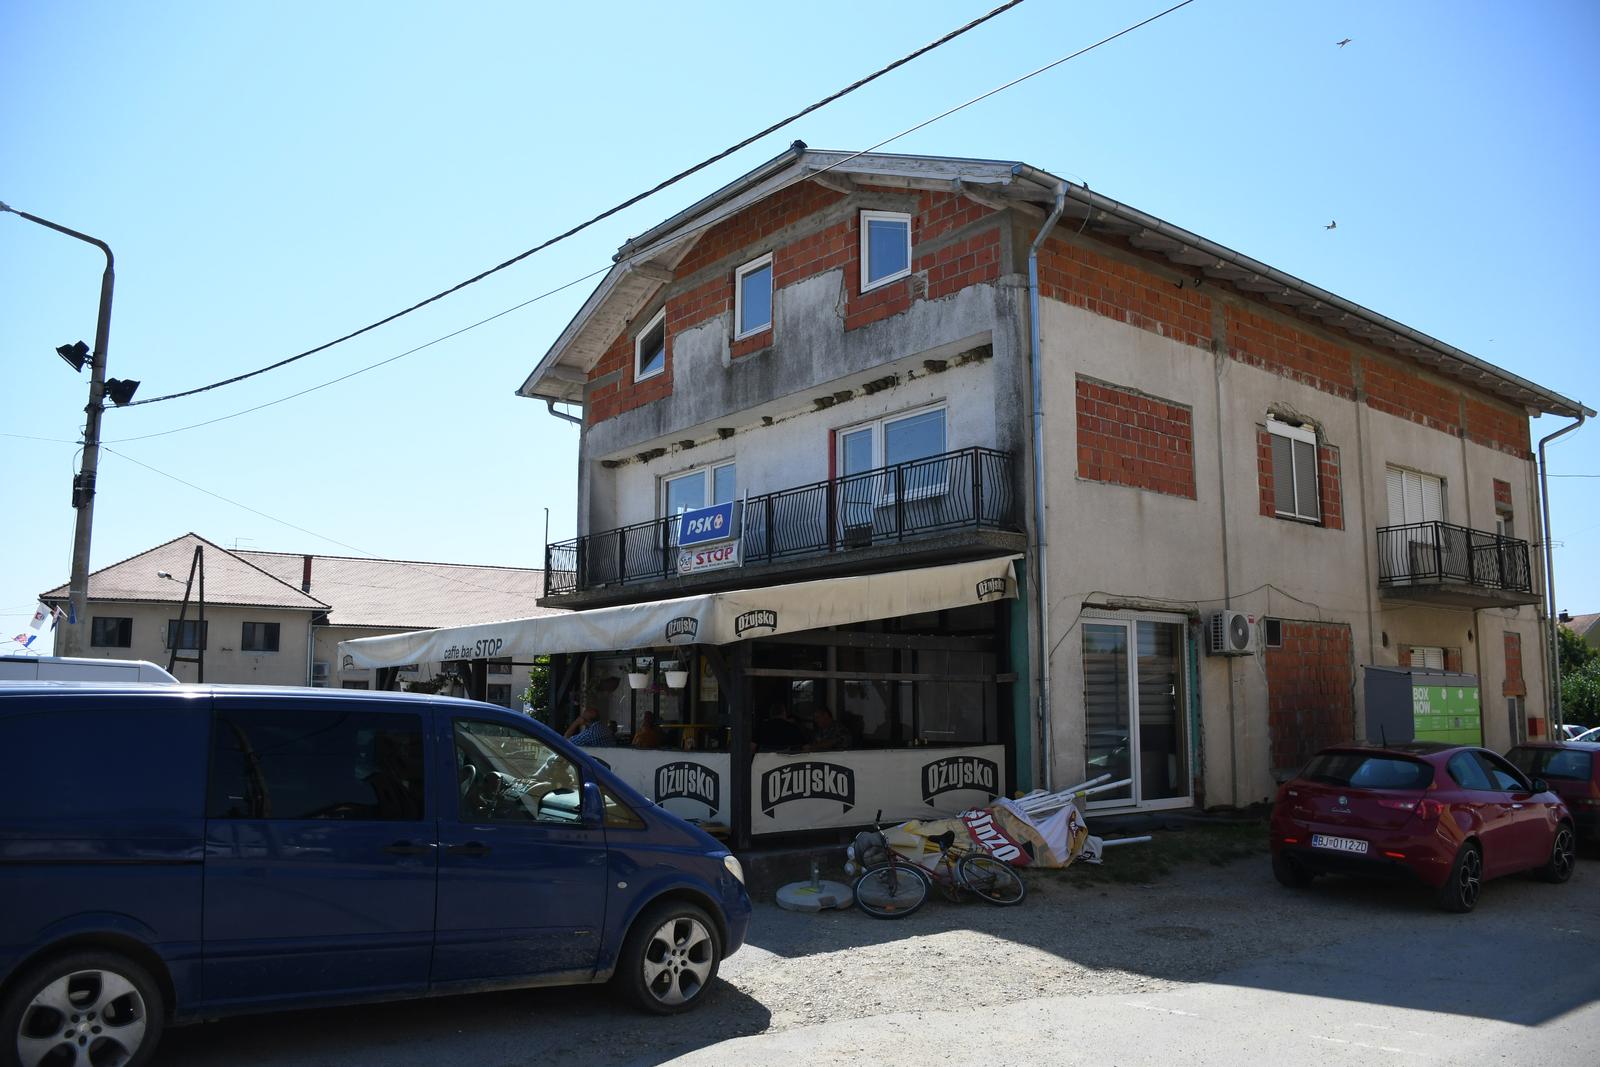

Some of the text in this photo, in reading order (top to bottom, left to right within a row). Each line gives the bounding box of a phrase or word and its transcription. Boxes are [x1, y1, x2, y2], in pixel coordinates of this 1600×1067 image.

[687, 515, 714, 536] PSK
[696, 546, 734, 565] STOP
[667, 617, 697, 637] Ožujsko
[738, 610, 774, 631] Ožujsko
[443, 638, 503, 660] caffe bar STOP
[1413, 687, 1430, 700] BOX
[1413, 701, 1431, 715] NOW
[659, 763, 714, 801] Ožujsko
[768, 763, 849, 803] Ožujsko
[928, 757, 993, 794] Ožujsko
[1318, 836, 1329, 847] BJ
